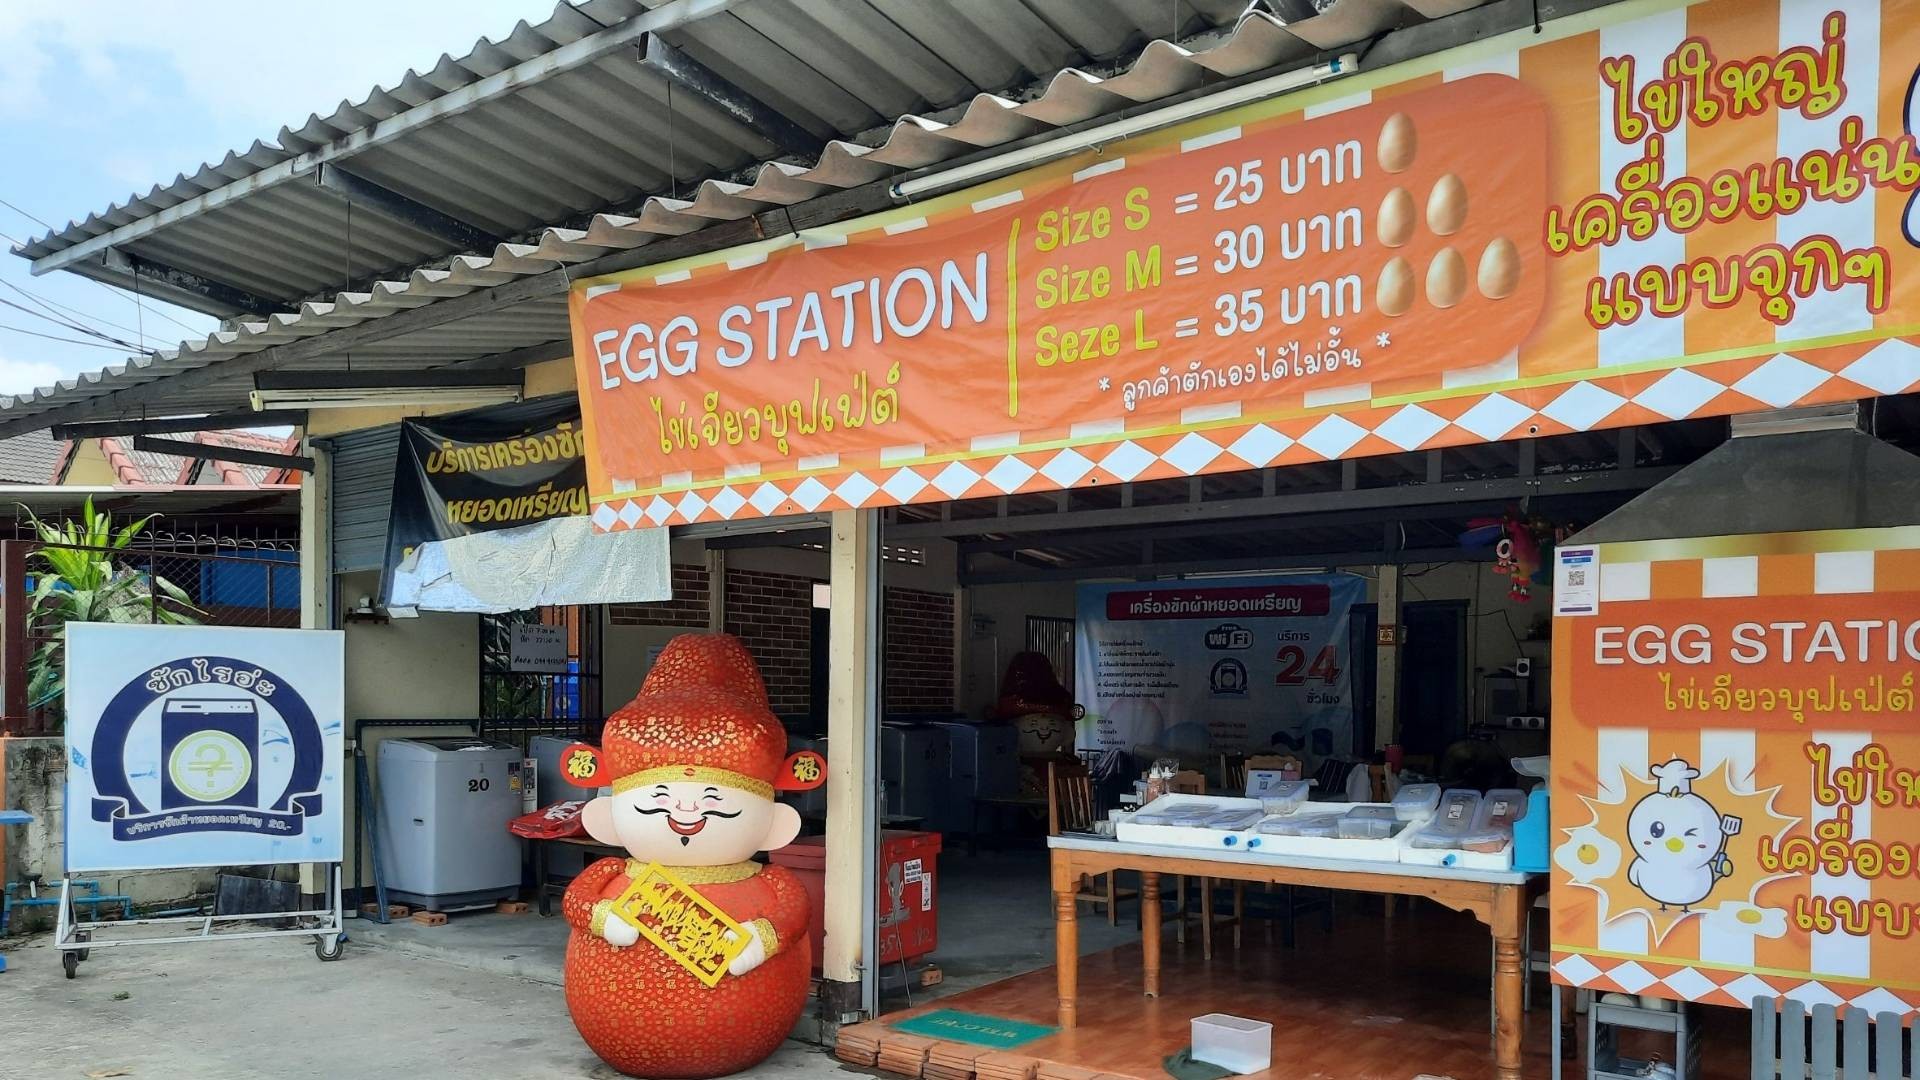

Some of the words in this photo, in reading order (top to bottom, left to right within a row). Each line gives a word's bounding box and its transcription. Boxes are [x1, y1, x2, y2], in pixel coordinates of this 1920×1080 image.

[1601, 11, 1846, 143] ไข่ใหญ่
[1035, 205, 1111, 252] Size
[1124, 187, 1151, 231] S
[1213, 159, 1265, 211] 25
[1280, 139, 1362, 195] บาท
[1035, 263, 1111, 309] Size
[1125, 244, 1161, 292] M
[1213, 224, 1265, 274] 30
[1280, 207, 1362, 260] บาท
[1585, 234, 1890, 329] แบบจุกๆ
[593, 316, 699, 389] EGG
[716, 251, 988, 368] STATION
[1035, 324, 1120, 367] Seze
[1135, 309, 1158, 350] L
[1213, 288, 1265, 337] 35
[1280, 273, 1362, 325] บาท
[1275, 644, 1340, 687] 24
[1277, 629, 1310, 641] บริการ
[1594, 624, 1713, 665] EGG
[468, 778, 490, 792] 20
[1759, 803, 1920, 879] เครื่อง
[1794, 895, 1920, 939] แบบ
